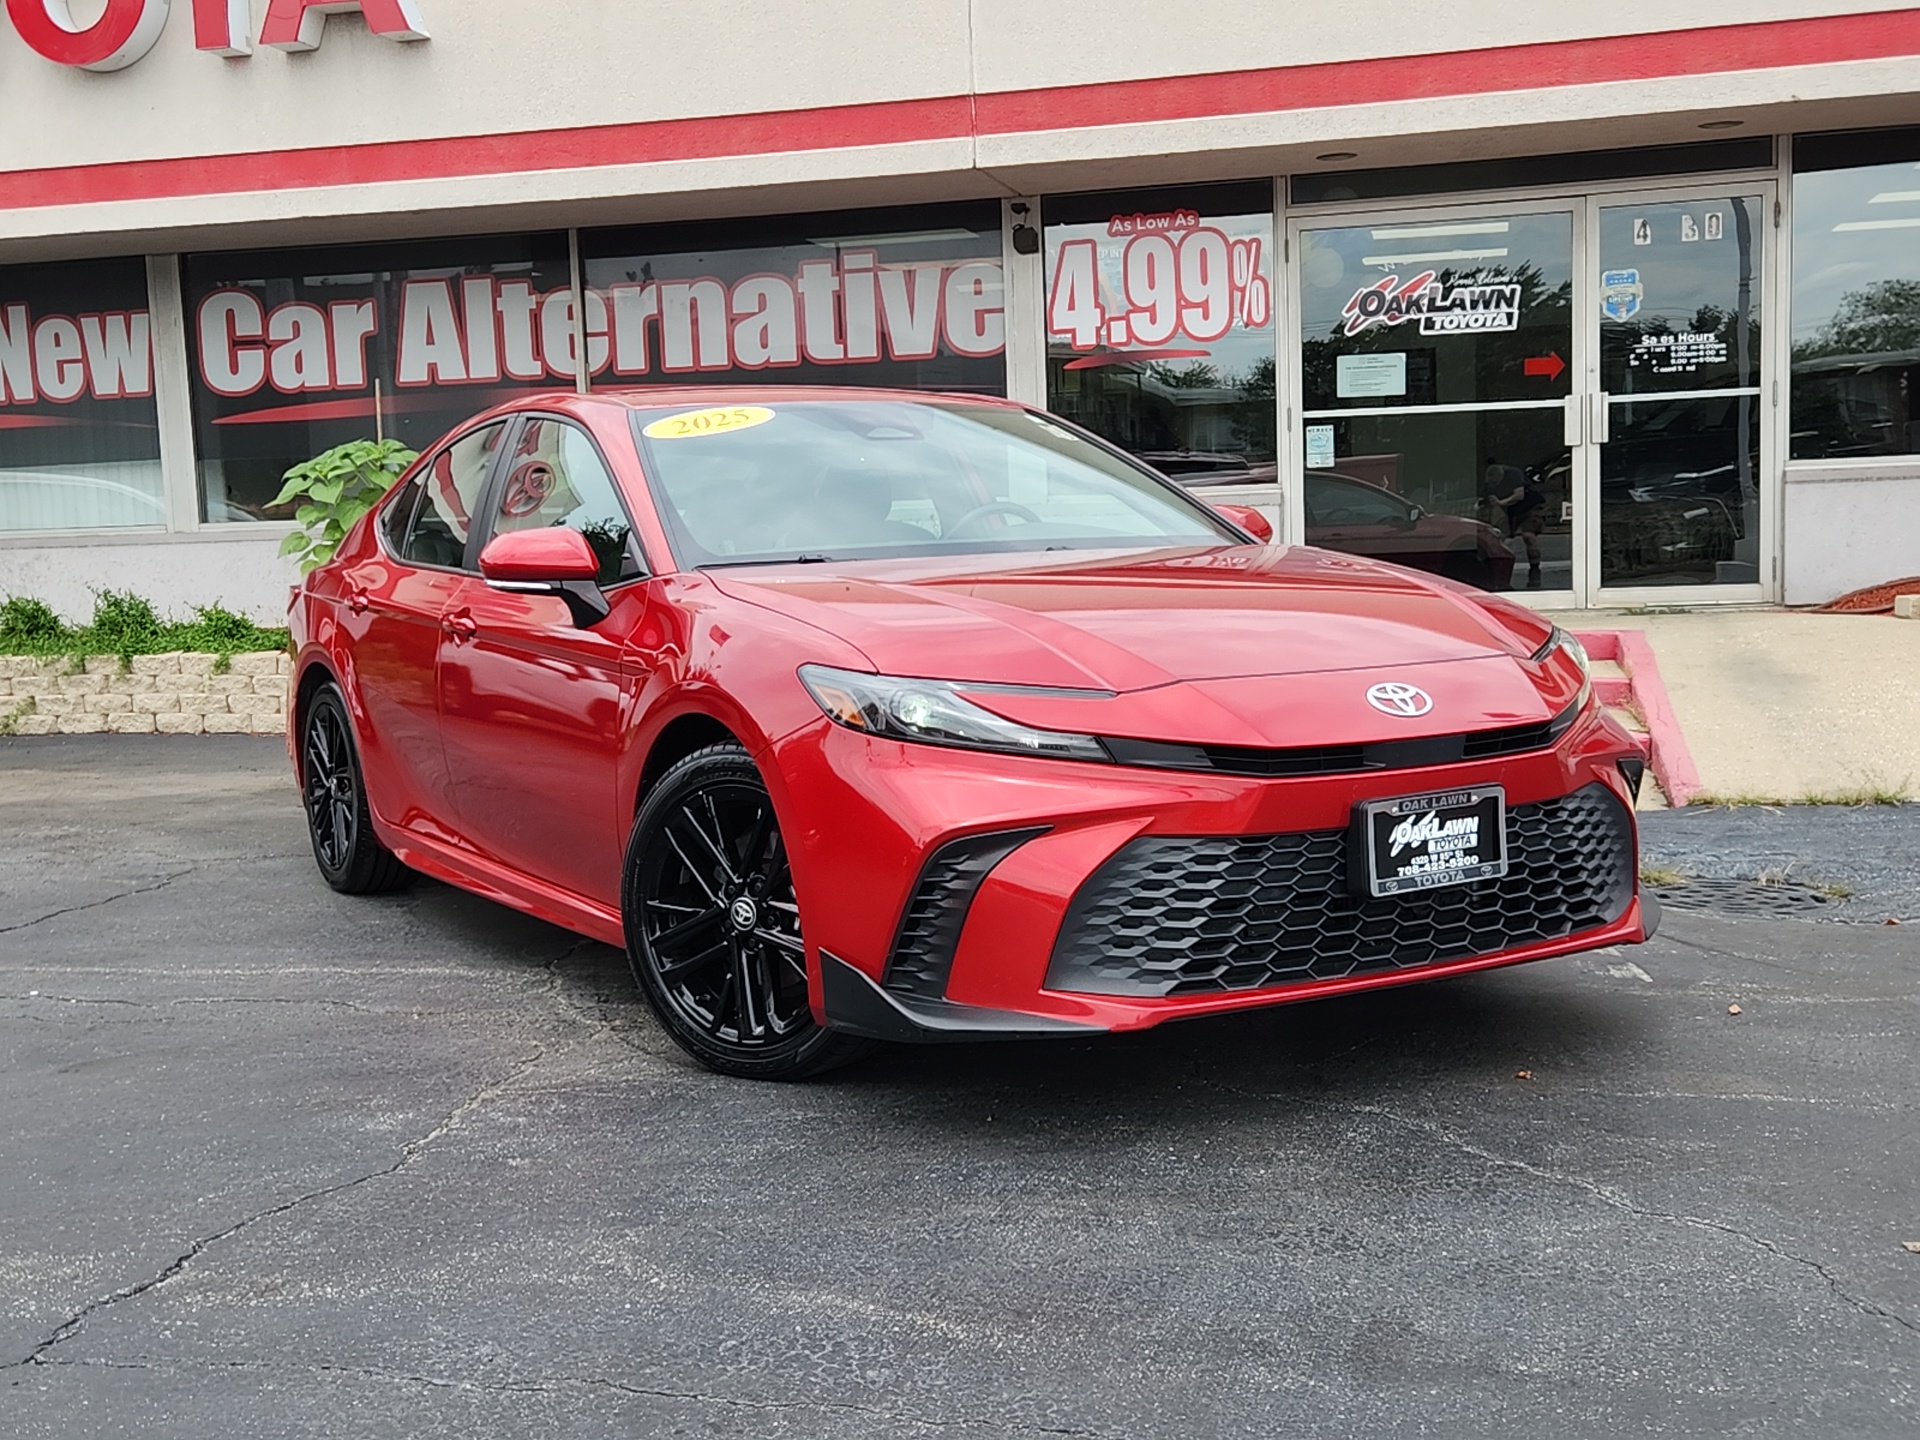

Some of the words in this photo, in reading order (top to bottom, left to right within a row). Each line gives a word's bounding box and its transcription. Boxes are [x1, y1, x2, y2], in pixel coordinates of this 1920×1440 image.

[1111, 218, 1132, 233] As
[1136, 214, 1170, 231] Low
[1174, 212, 1195, 227] As
[1048, 226, 1270, 350] 4.99%
[197, 287, 378, 396] Car
[397, 249, 1006, 388] Alternative
[1431, 313, 1509, 331] TOYOTA
[1641, 334, 1675, 345] Saes
[1677, 332, 1715, 343] Hours
[671, 408, 750, 435] 2025
[1402, 798, 1430, 812] OAK
[1431, 793, 1469, 808] LAWN
[1433, 835, 1472, 849] TOYOTA
[1414, 869, 1466, 888] TOYOTA
